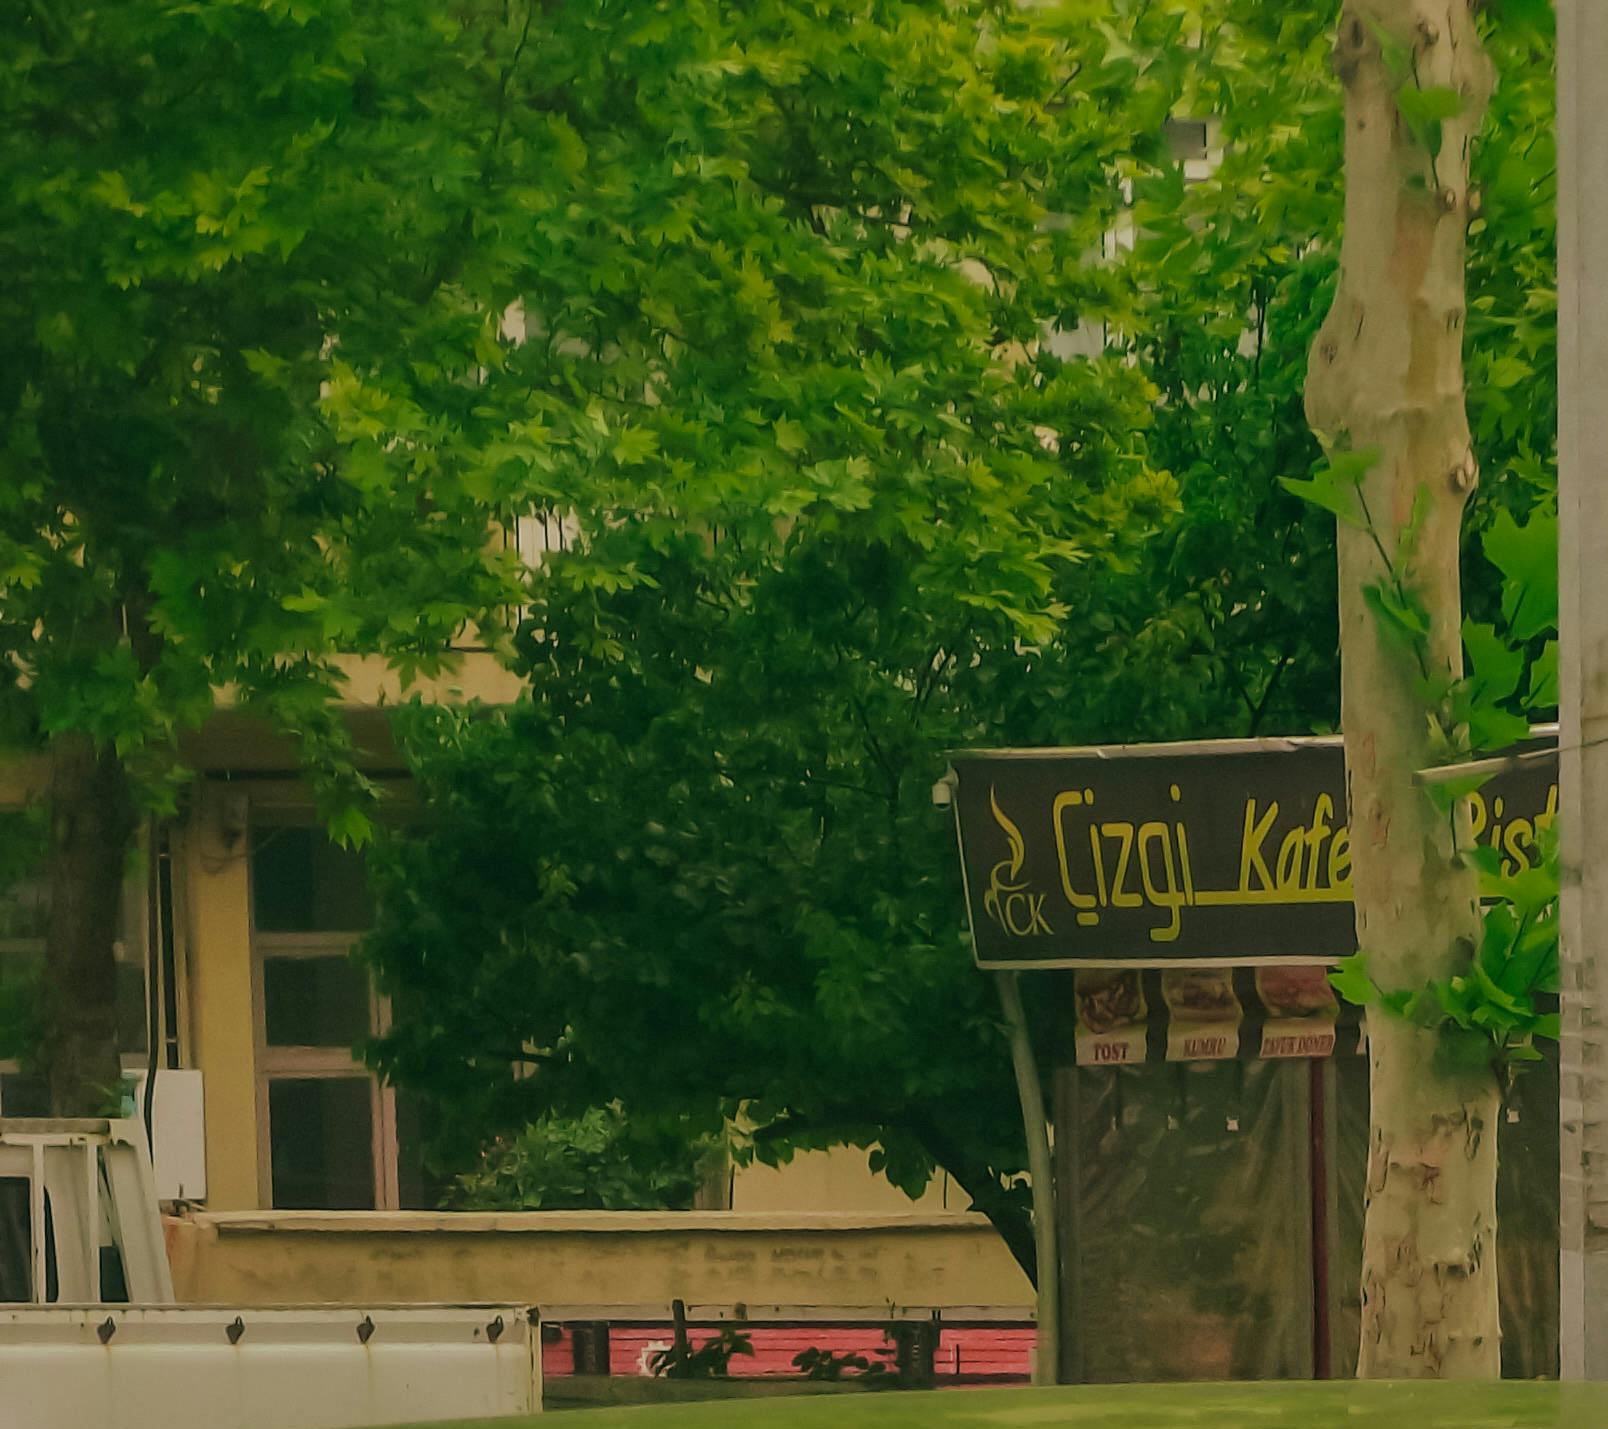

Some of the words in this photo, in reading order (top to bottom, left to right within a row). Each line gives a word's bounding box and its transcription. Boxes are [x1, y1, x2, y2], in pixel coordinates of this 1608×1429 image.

[1053, 784, 1194, 941] Çizgi
[1240, 792, 1353, 893] Kafe
[1093, 1042, 1129, 1061] TOST
